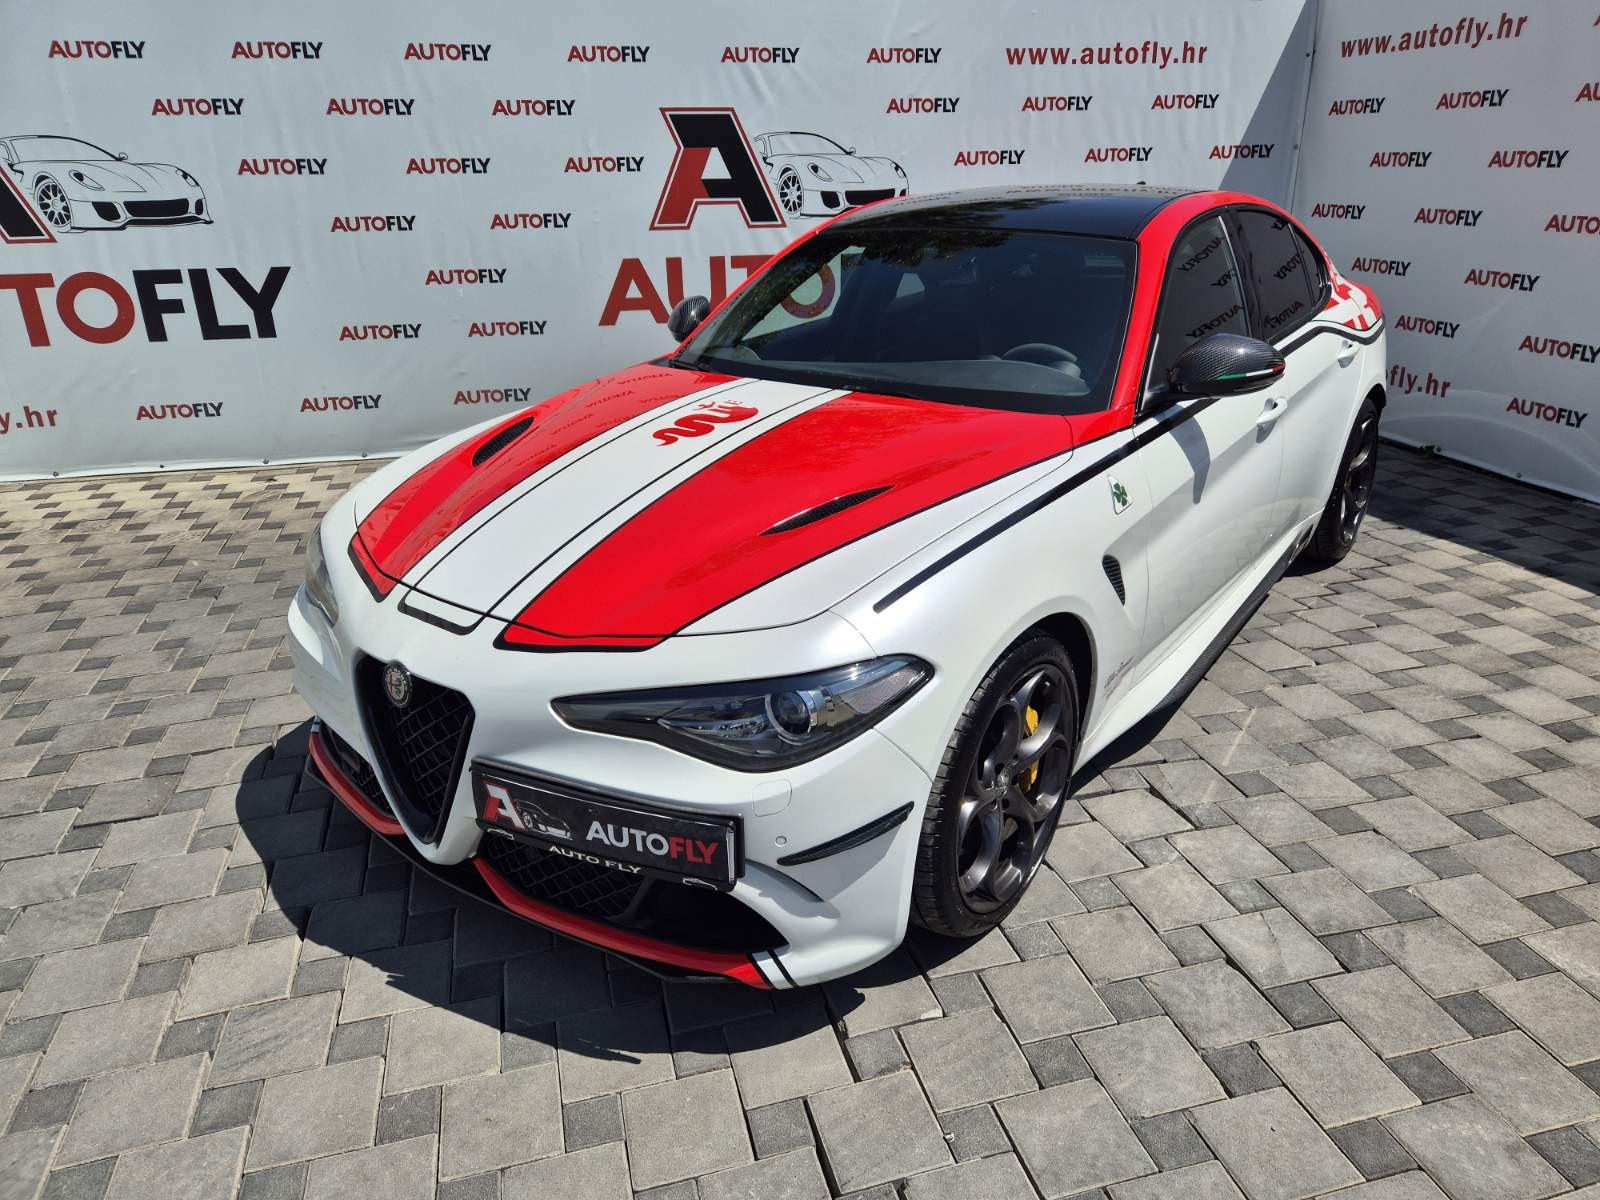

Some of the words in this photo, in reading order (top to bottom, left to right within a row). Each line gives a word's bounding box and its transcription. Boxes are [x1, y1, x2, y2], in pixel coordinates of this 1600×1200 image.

[1342, 13, 1528, 58] www.autofly.hr
[49, 41, 145, 58] AUTOFLY
[232, 42, 322, 59] AUTOFLY
[404, 43, 491, 61] AUTOFLY
[568, 46, 650, 62] AUTOFLY
[721, 47, 800, 63] AUTOFLY
[867, 48, 942, 63] AUTOFLY
[1006, 41, 1207, 69] www.autofly.hr
[152, 98, 244, 115] AUTOFLY
[327, 99, 414, 115] AUTOFLY
[492, 100, 575, 115] AUTOFLY
[886, 98, 959, 113] AUTOFLY
[1022, 96, 1092, 111] AUTOFLY
[1151, 94, 1219, 109] AUTOFLY
[1329, 97, 1385, 116] AUTOFLY
[1436, 89, 1509, 109] AUTOFLY
[954, 150, 1024, 166] AUTOFLY
[1085, 147, 1152, 162] AUTOFLY
[1209, 144, 1274, 160] AUTOFLY
[1370, 152, 1432, 167] AUTOFLY
[1488, 150, 1569, 168] AUTOFLY
[238, 159, 327, 175] AUTOFLY
[407, 158, 490, 174] AUTOFLY
[564, 157, 644, 172] AUTOFLY
[1312, 204, 1365, 219] AUTOFLY
[1414, 208, 1483, 226] AUTOFLY
[331, 216, 416, 232] AUTOFLY
[491, 213, 571, 229] AUTOFLY
[1544, 215, 1600, 234] AUTO
[1352, 257, 1411, 276] AUTOFLY
[426, 268, 507, 285] AUTOFLY
[1464, 269, 1540, 291] AUTOFLY
[340, 324, 421, 341] AUTOFLY
[469, 321, 547, 337] AUTOFLY
[1395, 315, 1460, 338] AUTOFLY
[1519, 336, 1600, 363] AUTOFLY
[1386, 365, 1451, 398] fly.hr
[300, 395, 381, 412] AUTOFLY
[454, 388, 531, 405] AUTOFLY
[136, 402, 223, 420] AUTOFLY
[1506, 398, 1587, 428] AUTOFLY
[586, 821, 719, 865] AUTOFLY
[549, 845, 599, 864] AUTO
[604, 860, 643, 874] FLY
